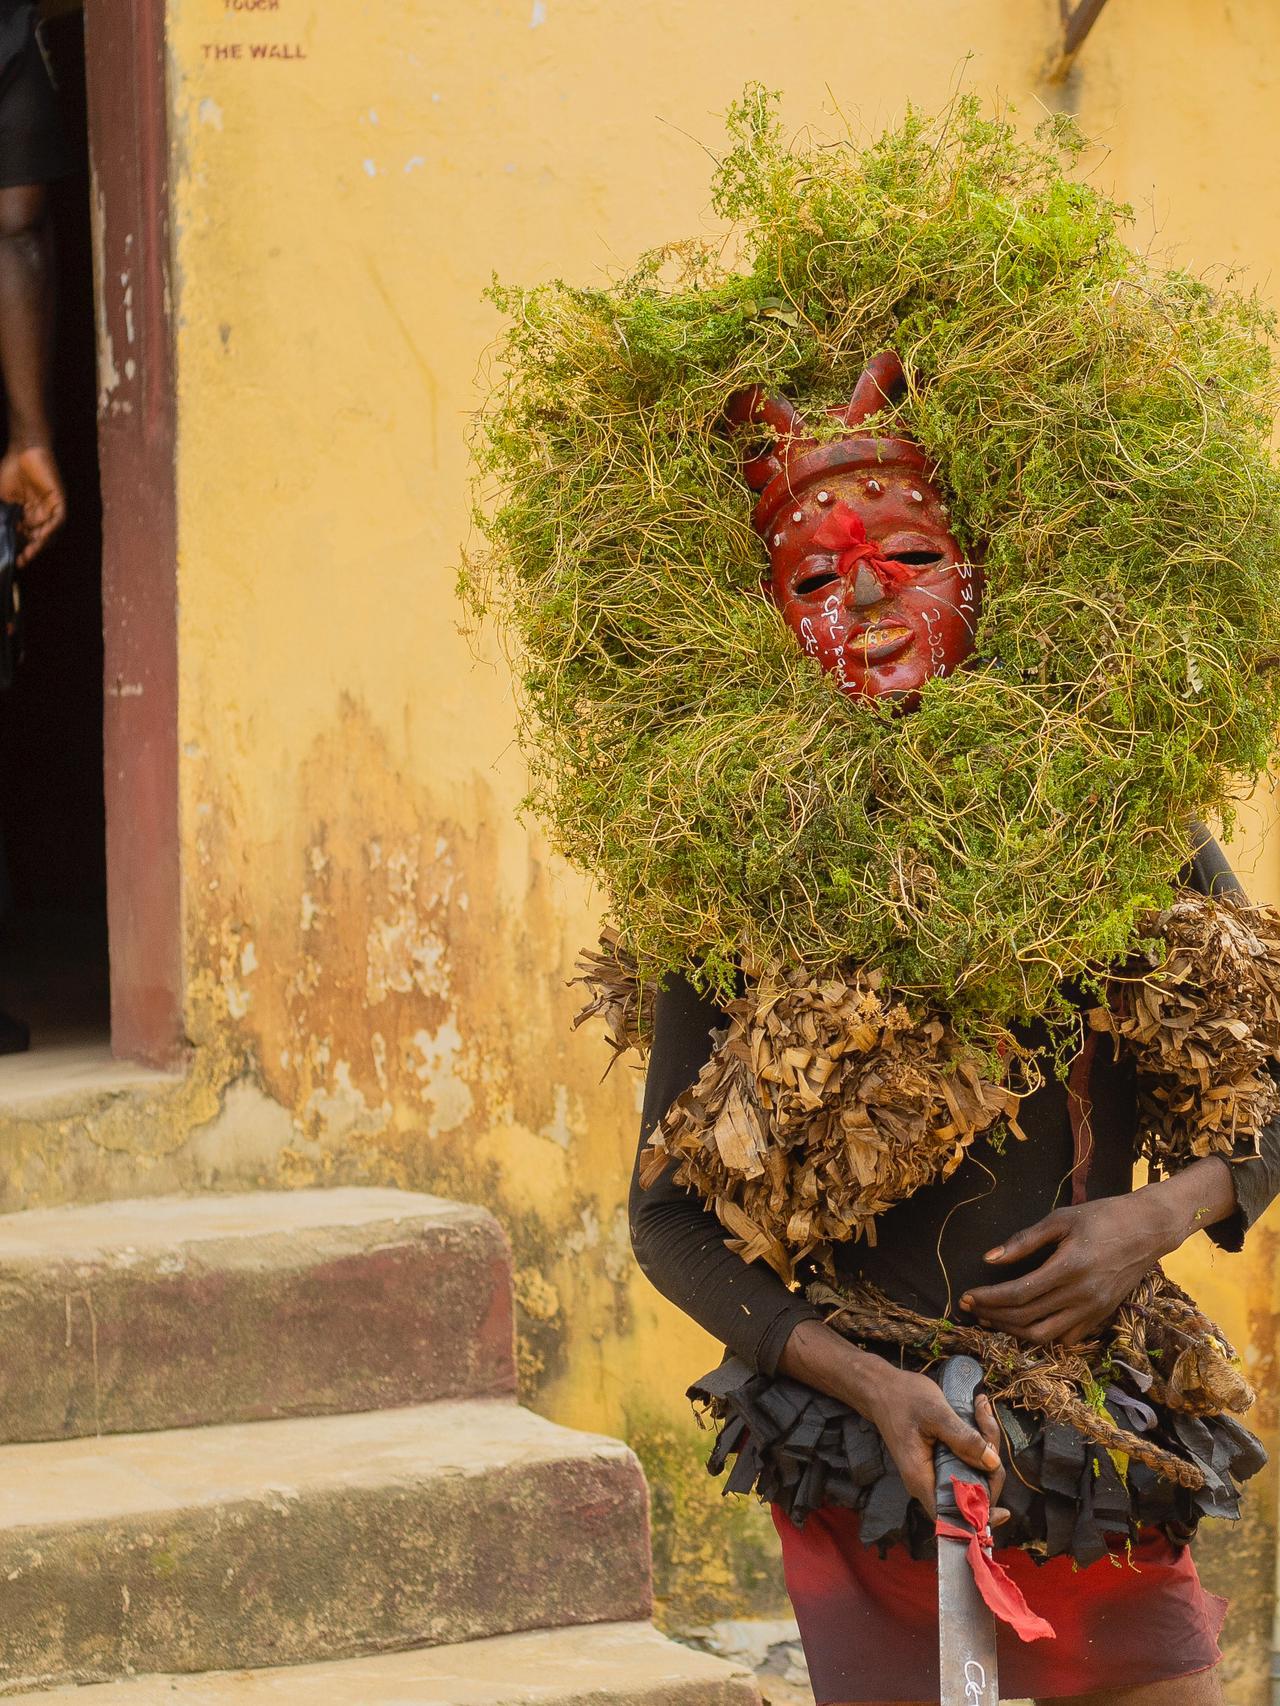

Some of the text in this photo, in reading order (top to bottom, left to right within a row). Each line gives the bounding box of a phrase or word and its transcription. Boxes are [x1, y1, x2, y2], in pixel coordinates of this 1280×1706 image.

[224, 0, 279, 11] TOUCH
[201, 43, 307, 59] THE WALL
